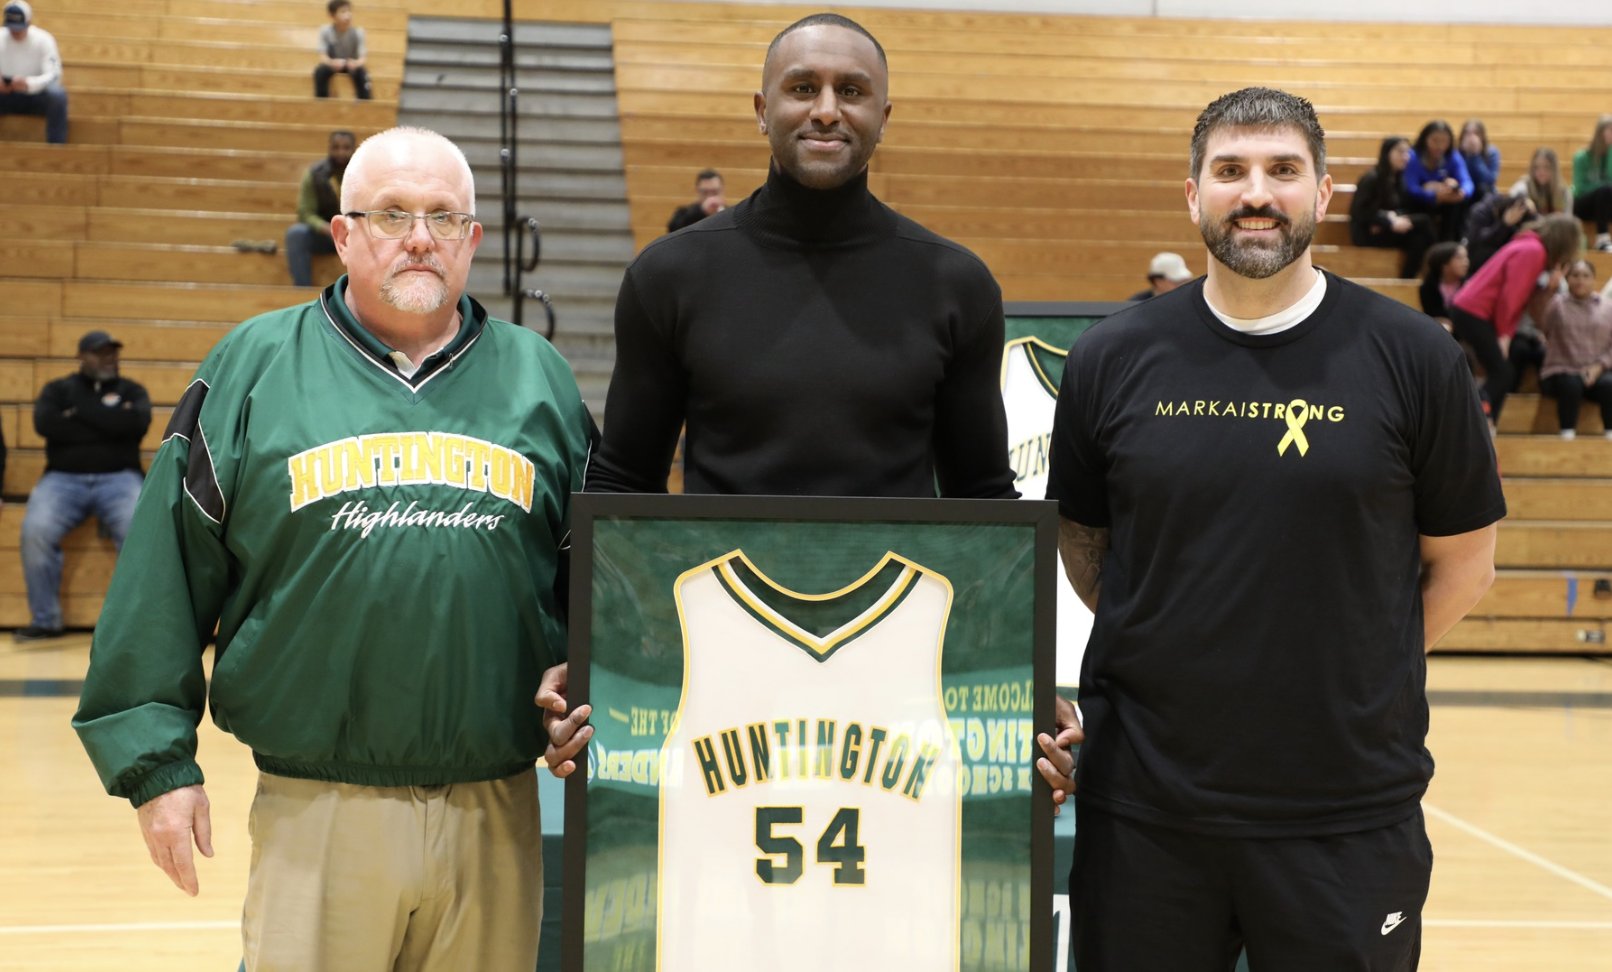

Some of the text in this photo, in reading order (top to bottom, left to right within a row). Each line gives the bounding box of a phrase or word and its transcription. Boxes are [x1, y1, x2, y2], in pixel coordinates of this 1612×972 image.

[288, 431, 535, 514] HUNTINGTON
[331, 500, 505, 539] Highlanders
[691, 718, 943, 803] HUNTINGTON
[754, 804, 866, 888] 54
